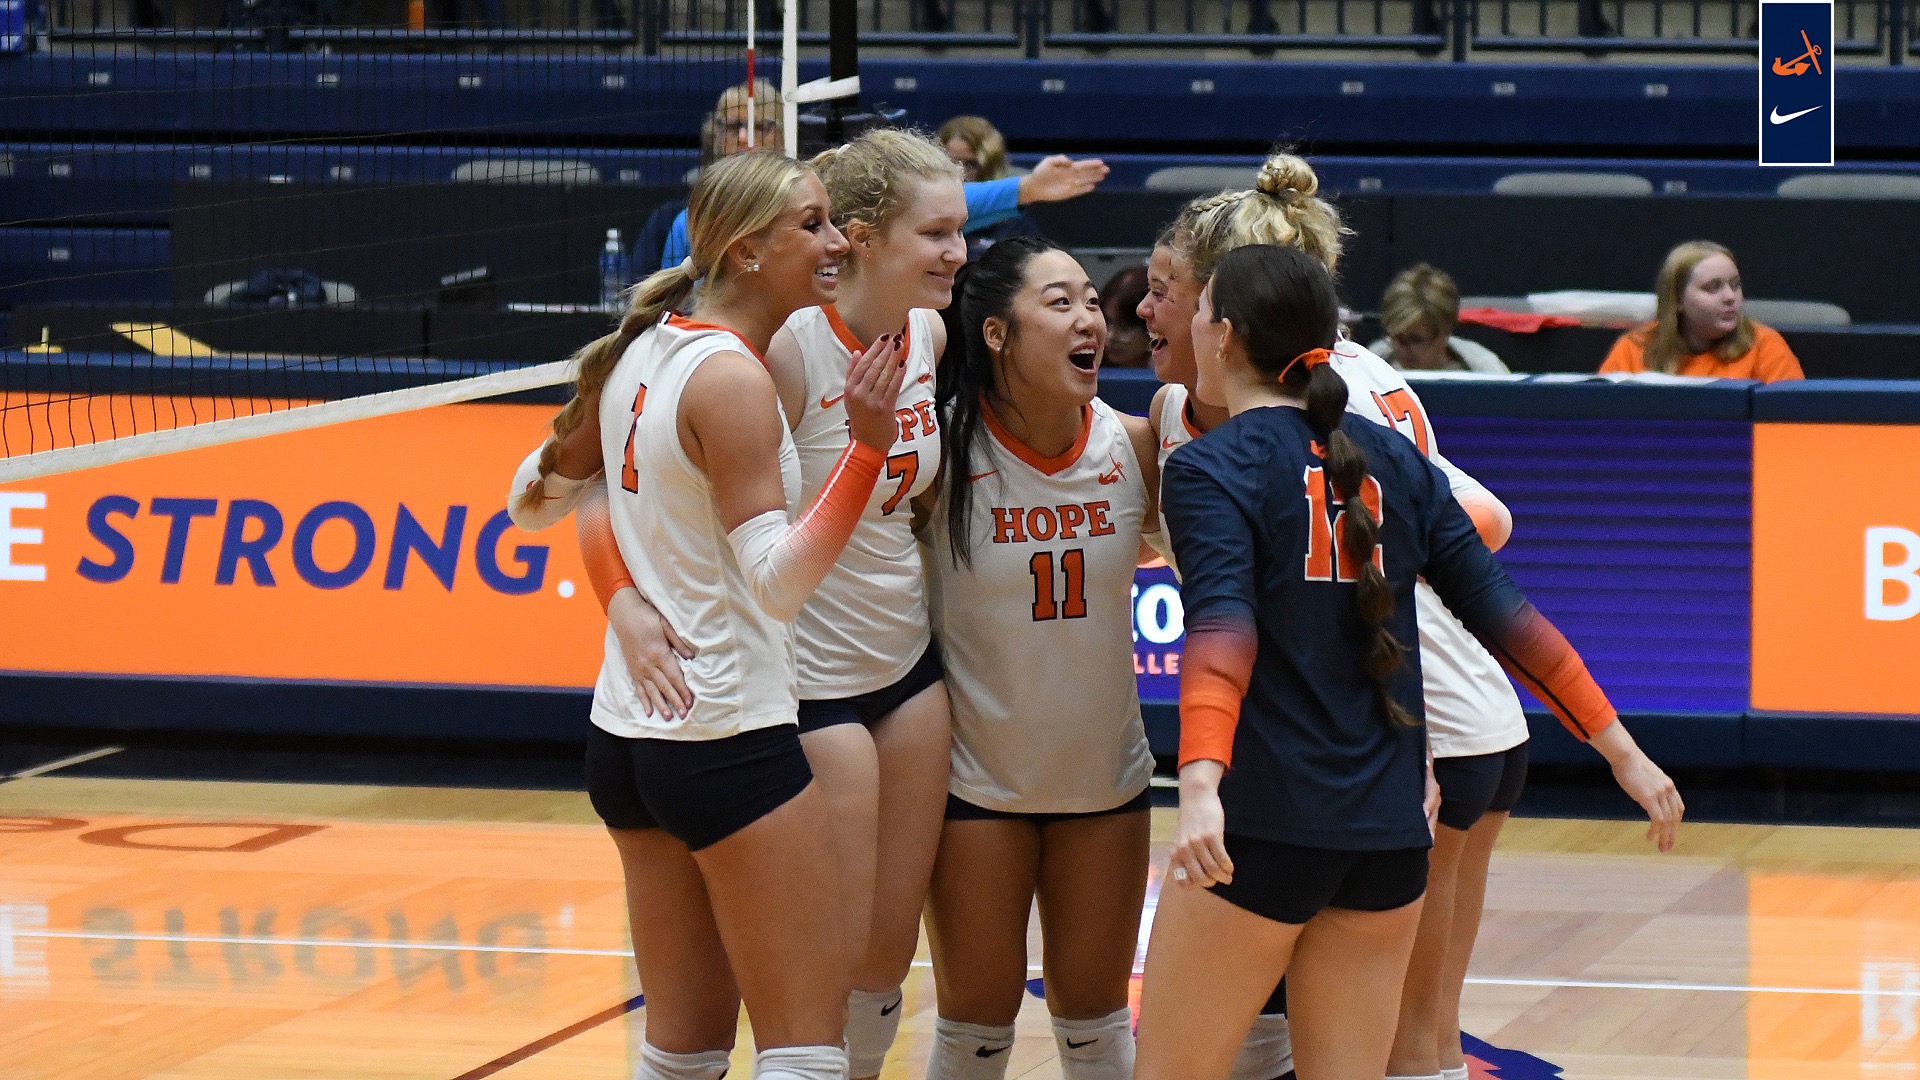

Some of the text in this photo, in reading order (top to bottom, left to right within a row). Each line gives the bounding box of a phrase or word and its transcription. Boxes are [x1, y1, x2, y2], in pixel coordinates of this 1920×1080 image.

[845, 399, 937, 443] PE
[881, 450, 919, 516] 7
[76, 494, 575, 598] STRONG.
[991, 500, 1116, 543] HOPE
[1029, 548, 1087, 622] 11
